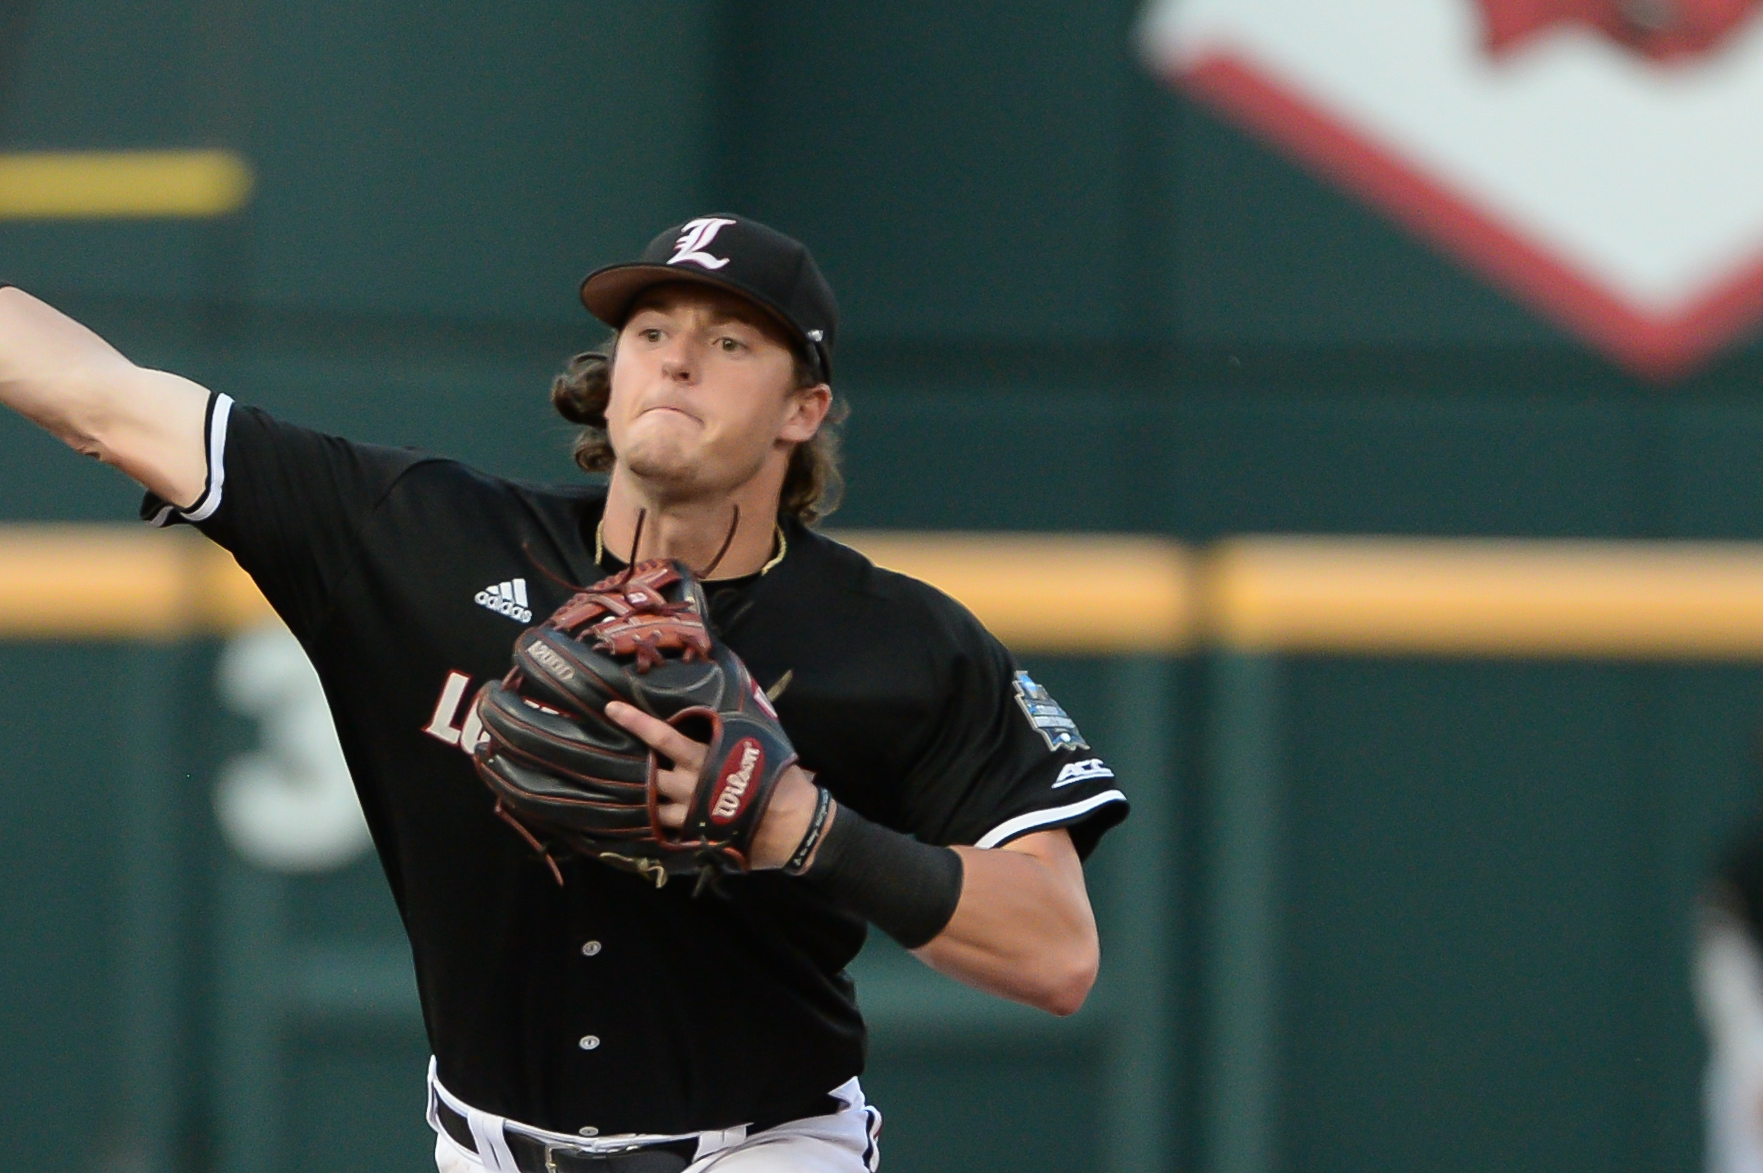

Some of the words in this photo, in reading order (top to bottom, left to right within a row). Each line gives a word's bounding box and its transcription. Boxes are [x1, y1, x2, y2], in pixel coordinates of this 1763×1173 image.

[666, 217, 737, 270] L
[474, 590, 533, 624] adidas
[711, 746, 761, 818] Wilson
[1054, 758, 1114, 788] ACC
